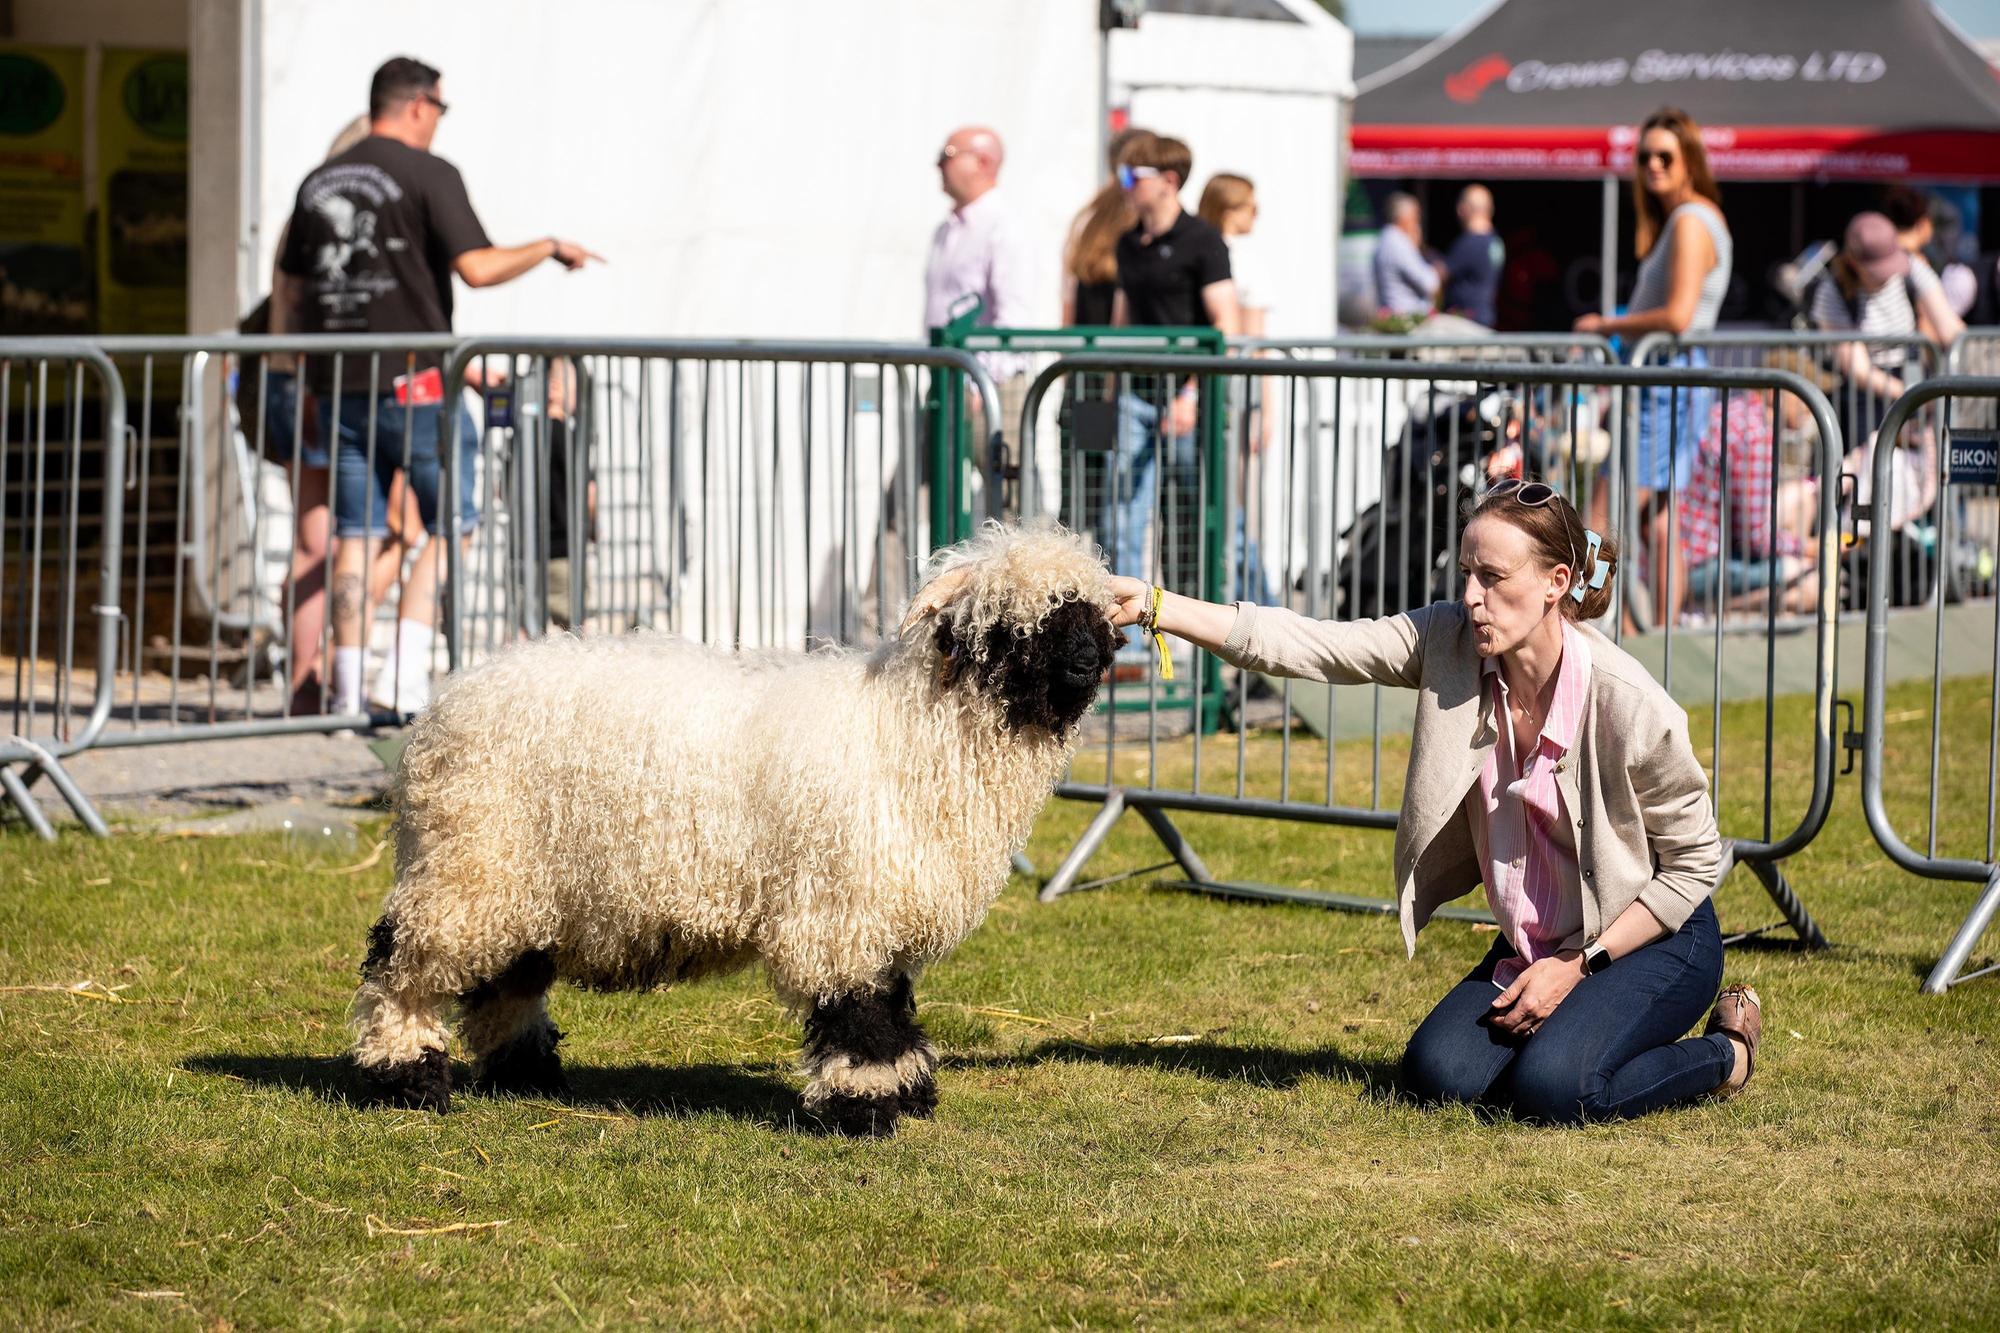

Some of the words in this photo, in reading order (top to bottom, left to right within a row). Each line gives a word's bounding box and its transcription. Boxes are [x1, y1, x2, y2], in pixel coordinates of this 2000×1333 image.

[1631, 48, 1797, 83] Services
[1801, 50, 1887, 83] LTD
[1951, 449, 1997, 466] EIKON
